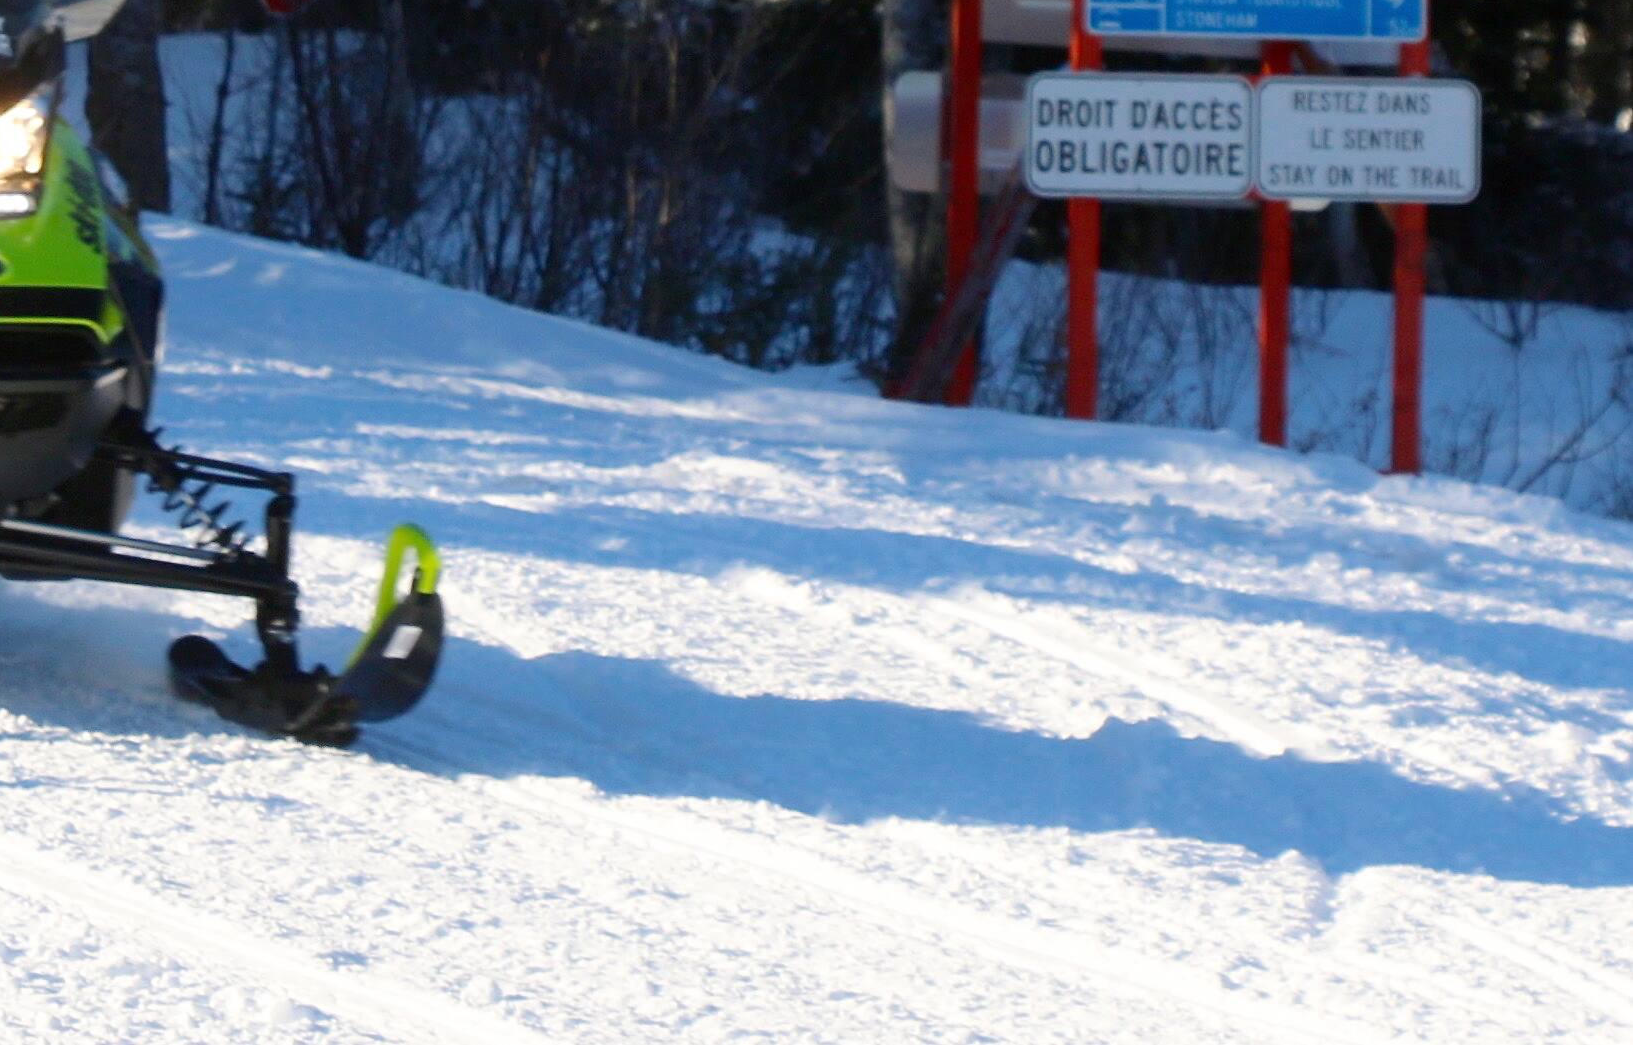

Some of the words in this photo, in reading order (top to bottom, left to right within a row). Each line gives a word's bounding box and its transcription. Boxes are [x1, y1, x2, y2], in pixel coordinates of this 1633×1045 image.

[1037, 97, 1117, 128] DROIT
[1131, 97, 1243, 131] D'ACCÈS
[1293, 90, 1366, 114] RESTEZ
[1376, 92, 1431, 116] DANS
[1310, 128, 1333, 150] LE
[1342, 128, 1426, 152] SENTIER
[1035, 139, 1245, 176] OBLIGATOIRE
[1269, 163, 1317, 186] STAY
[1327, 165, 1354, 187] ON
[1365, 166, 1399, 188] THE
[1411, 167, 1464, 189] TRAIL
